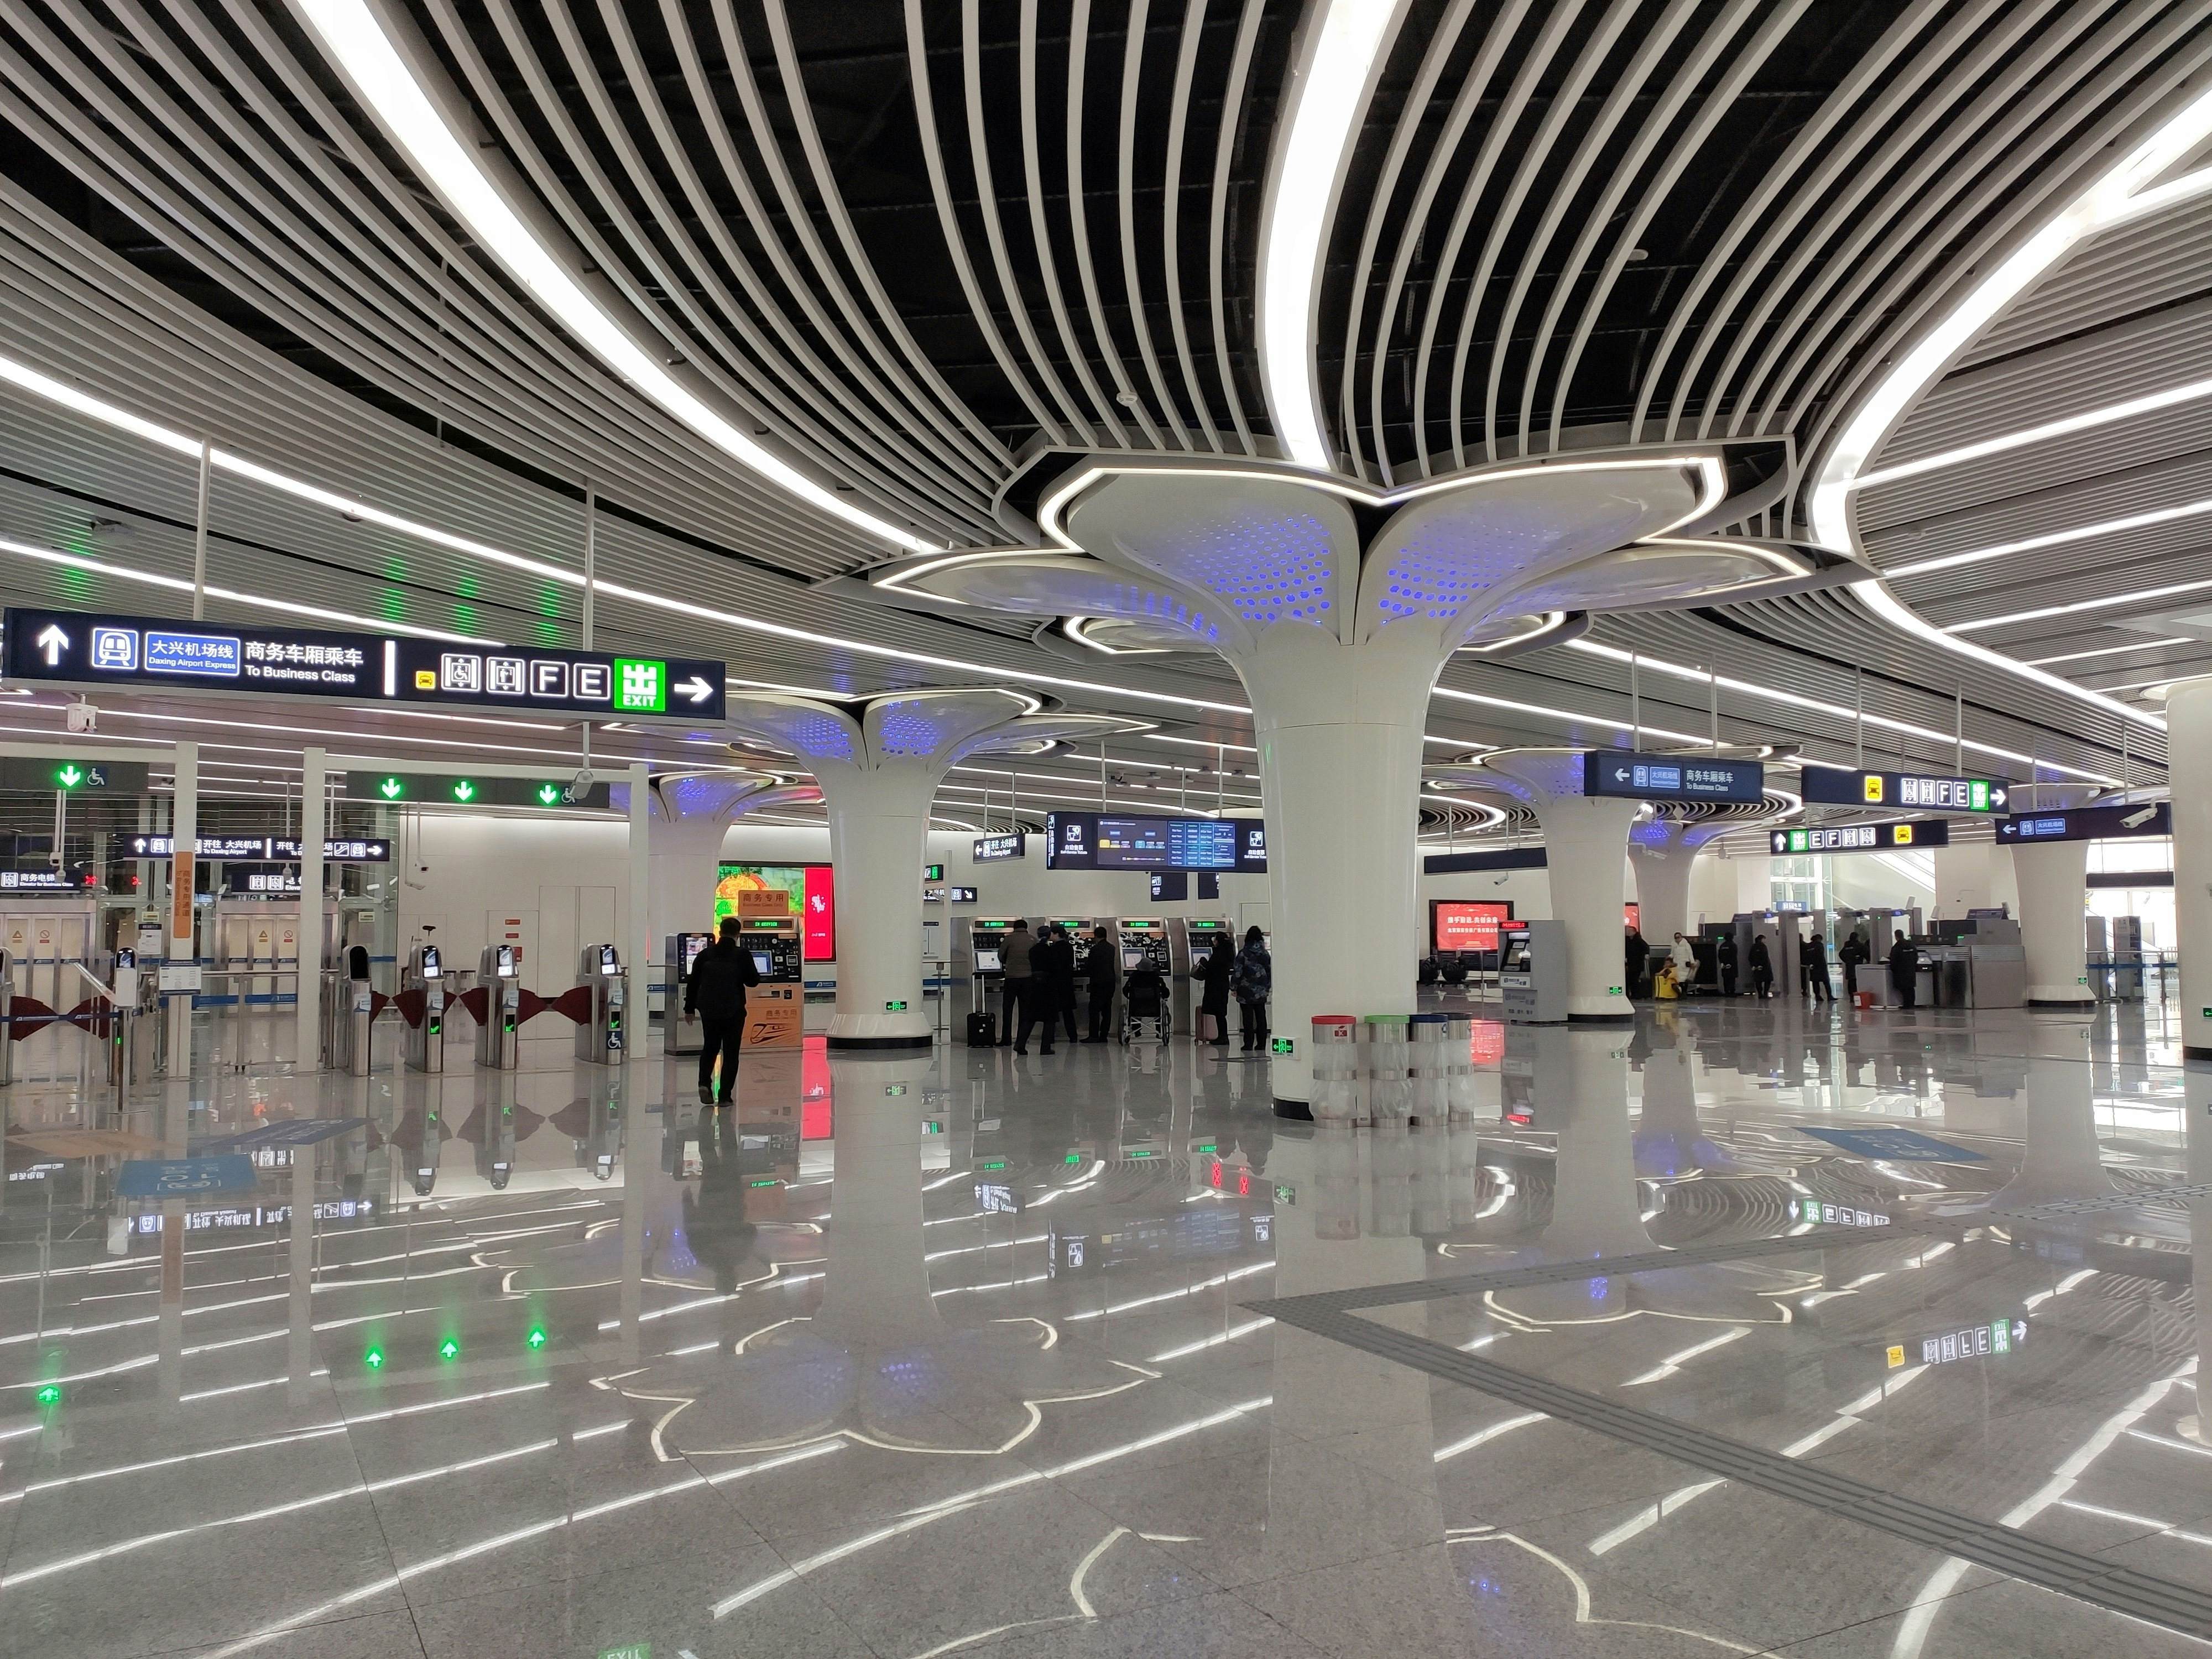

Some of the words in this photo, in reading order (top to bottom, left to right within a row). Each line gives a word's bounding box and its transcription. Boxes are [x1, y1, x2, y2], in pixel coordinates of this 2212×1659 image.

[151, 640, 234, 659] 大兴机场线
[245, 641, 363, 667] 商务车厢乘车
[149, 657, 176, 667] Daxing
[178, 659, 203, 667] Airport
[205, 661, 236, 669] Express
[244, 665, 260, 676] To
[263, 666, 319, 680] Business
[321, 670, 356, 682] Class
[539, 666, 559, 691] F
[581, 669, 602, 695] E
[623, 695, 656, 707] EXIT
[1687, 770, 1734, 783] 商务车厢乘车
[1940, 785, 1949, 802] F
[1957, 786, 1966, 802] E
[204, 839, 221, 848] 开往
[226, 840, 262, 849] 大兴机场
[1000, 838, 1017, 848] 大兴机场
[1812, 833, 1821, 846] E
[1828, 833, 1837, 844] F
[276, 842, 294, 851] 开往
[743, 894, 784, 902] 商务专用
